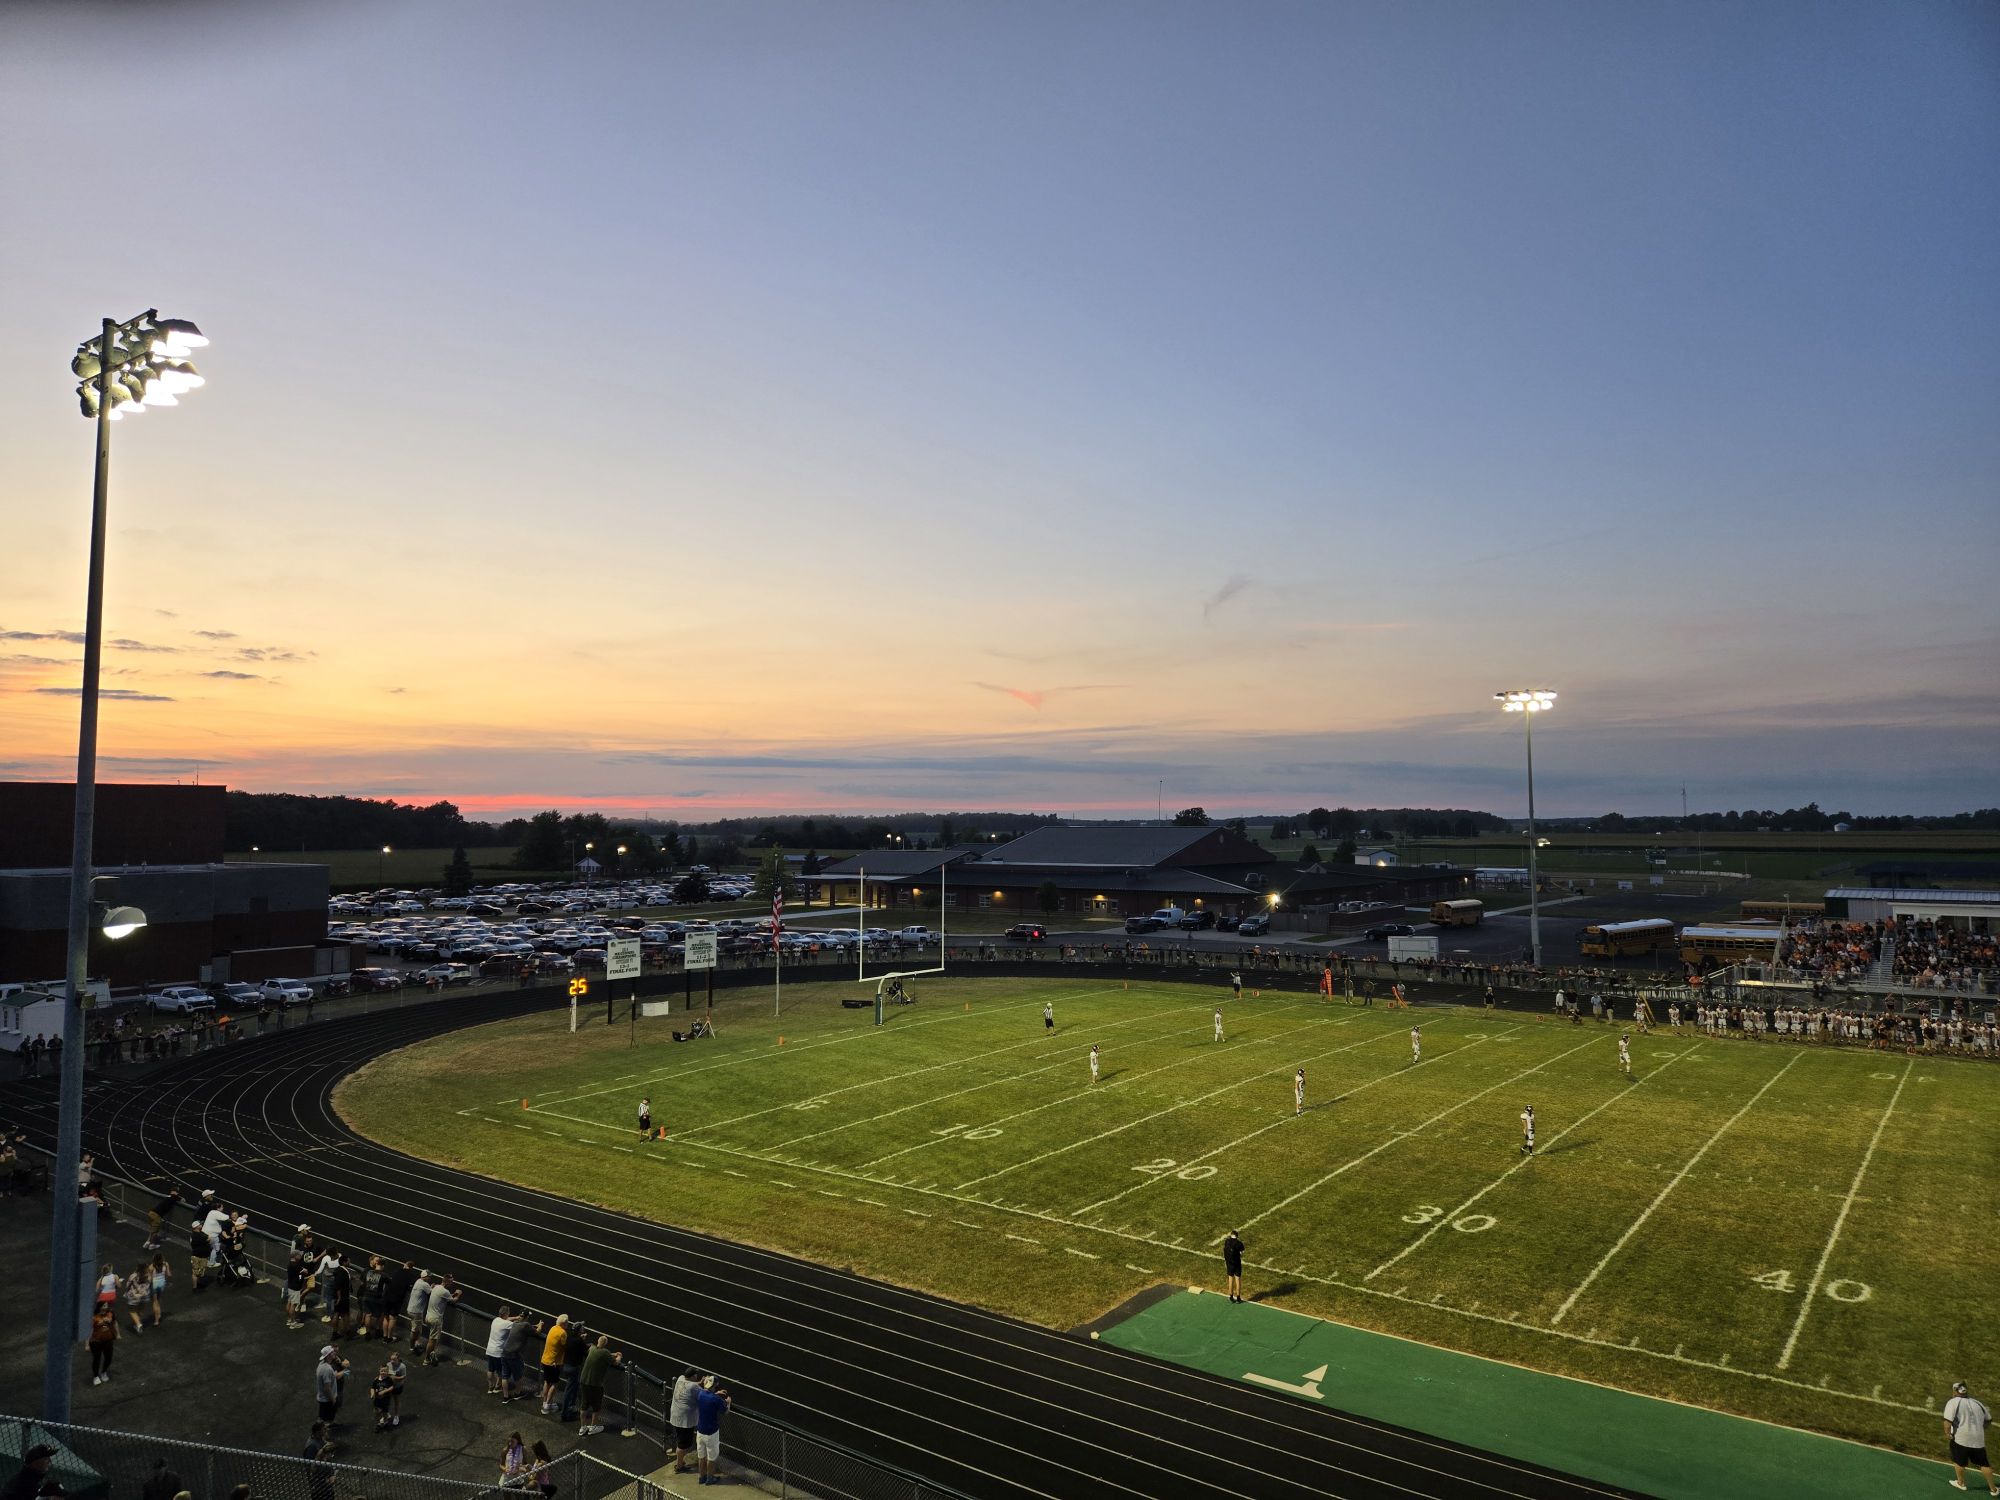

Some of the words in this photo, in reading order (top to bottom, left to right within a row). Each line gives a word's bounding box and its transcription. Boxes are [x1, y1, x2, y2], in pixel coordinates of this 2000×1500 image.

[570, 979, 586, 995] 25
[930, 1122, 1003, 1139] 10
[1131, 1158, 1218, 1180] 20
[1401, 1205, 1497, 1232] 30
[1750, 1269, 1871, 1302] 40
